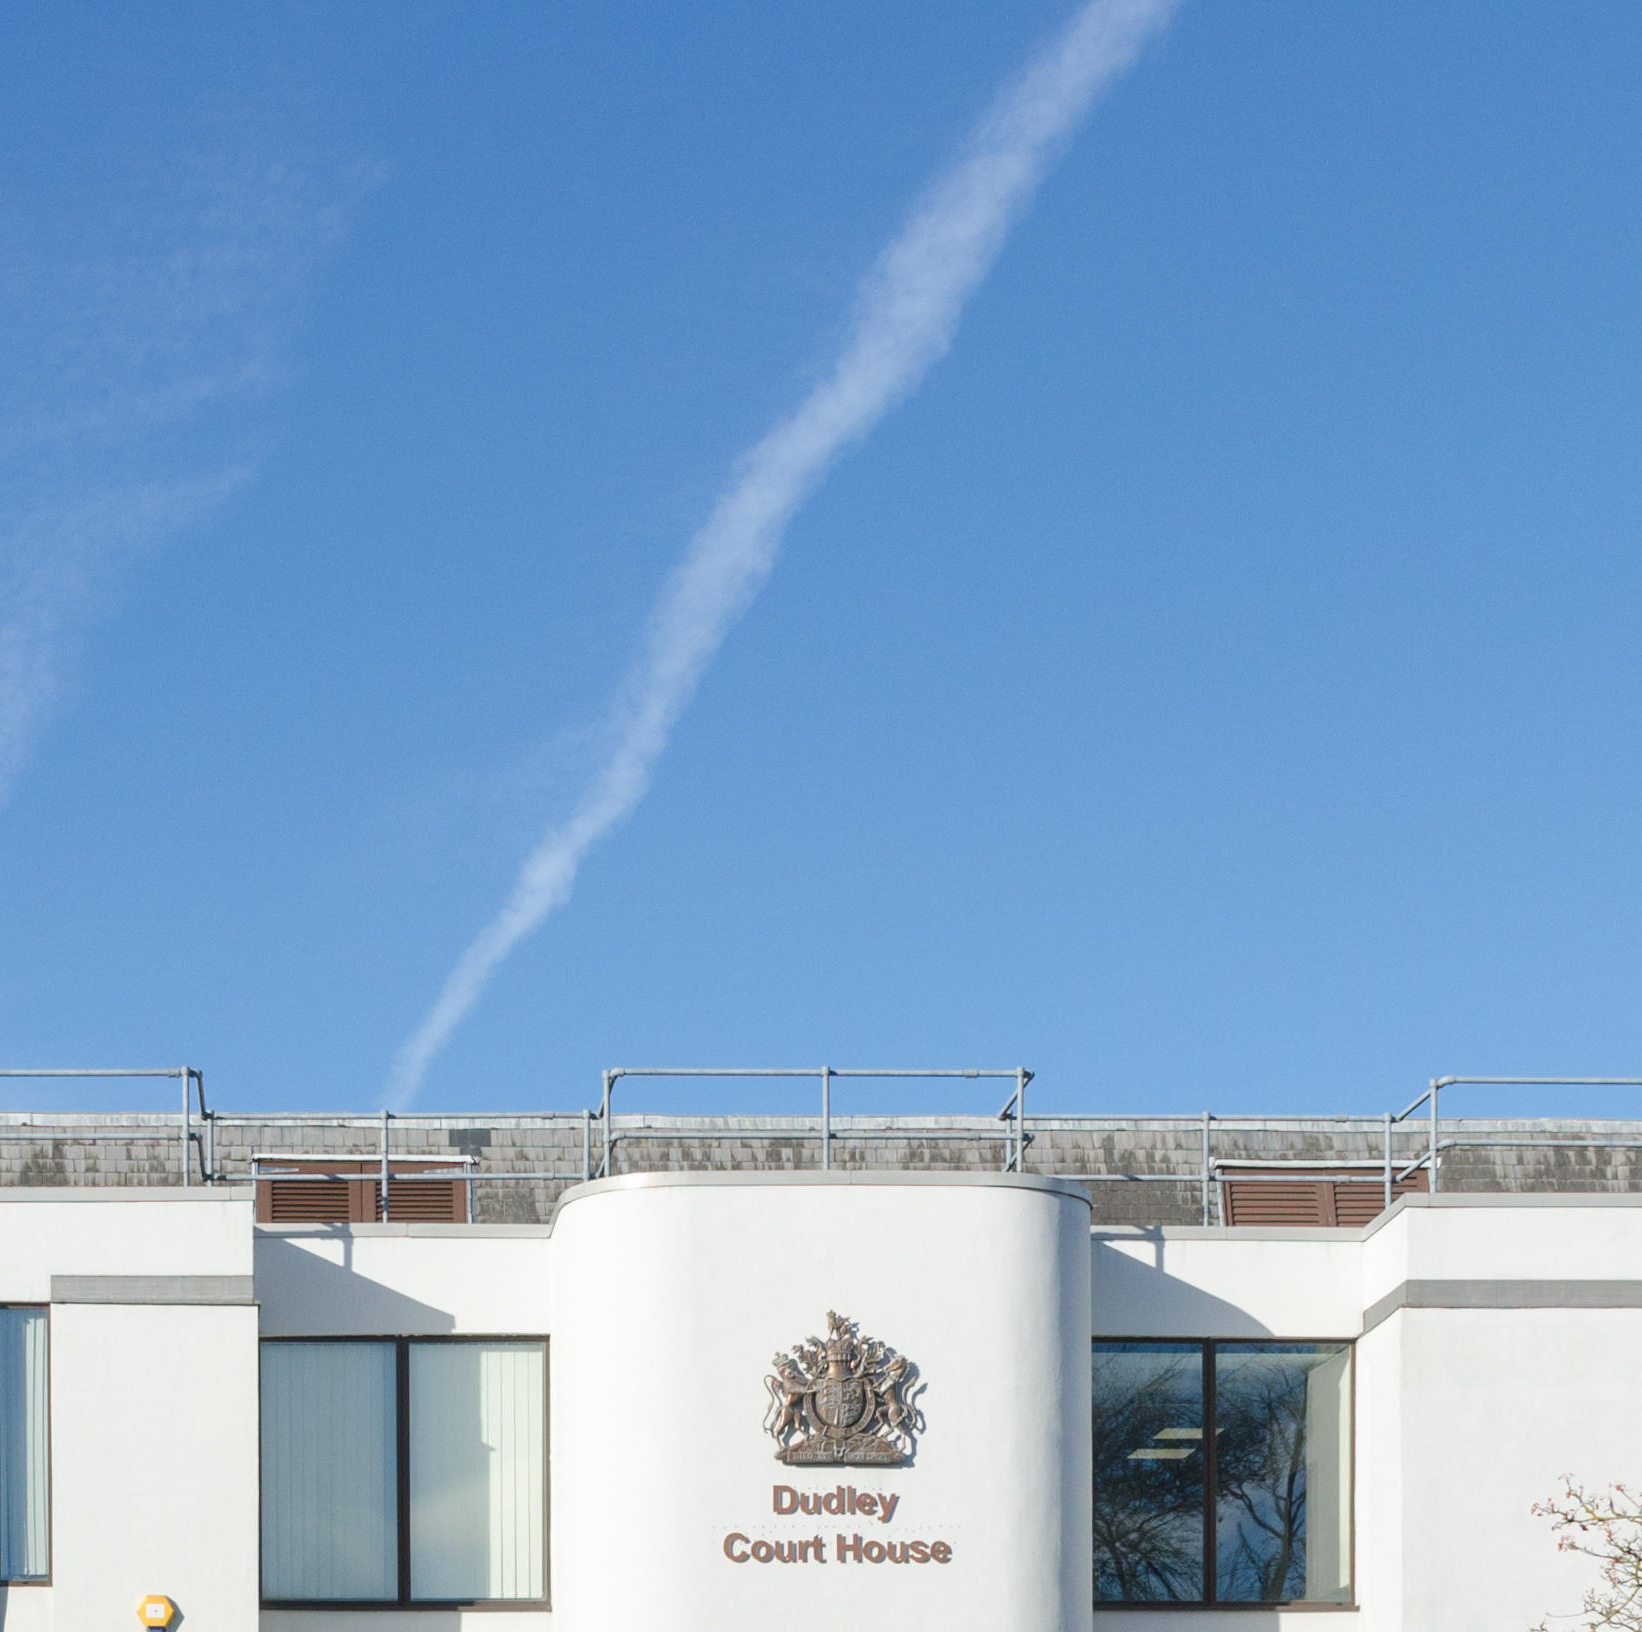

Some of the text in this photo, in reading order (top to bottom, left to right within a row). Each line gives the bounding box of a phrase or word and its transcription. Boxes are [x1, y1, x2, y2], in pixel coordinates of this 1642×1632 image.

[772, 1484, 899, 1523] Dudley
[723, 1532, 952, 1563] Court House
